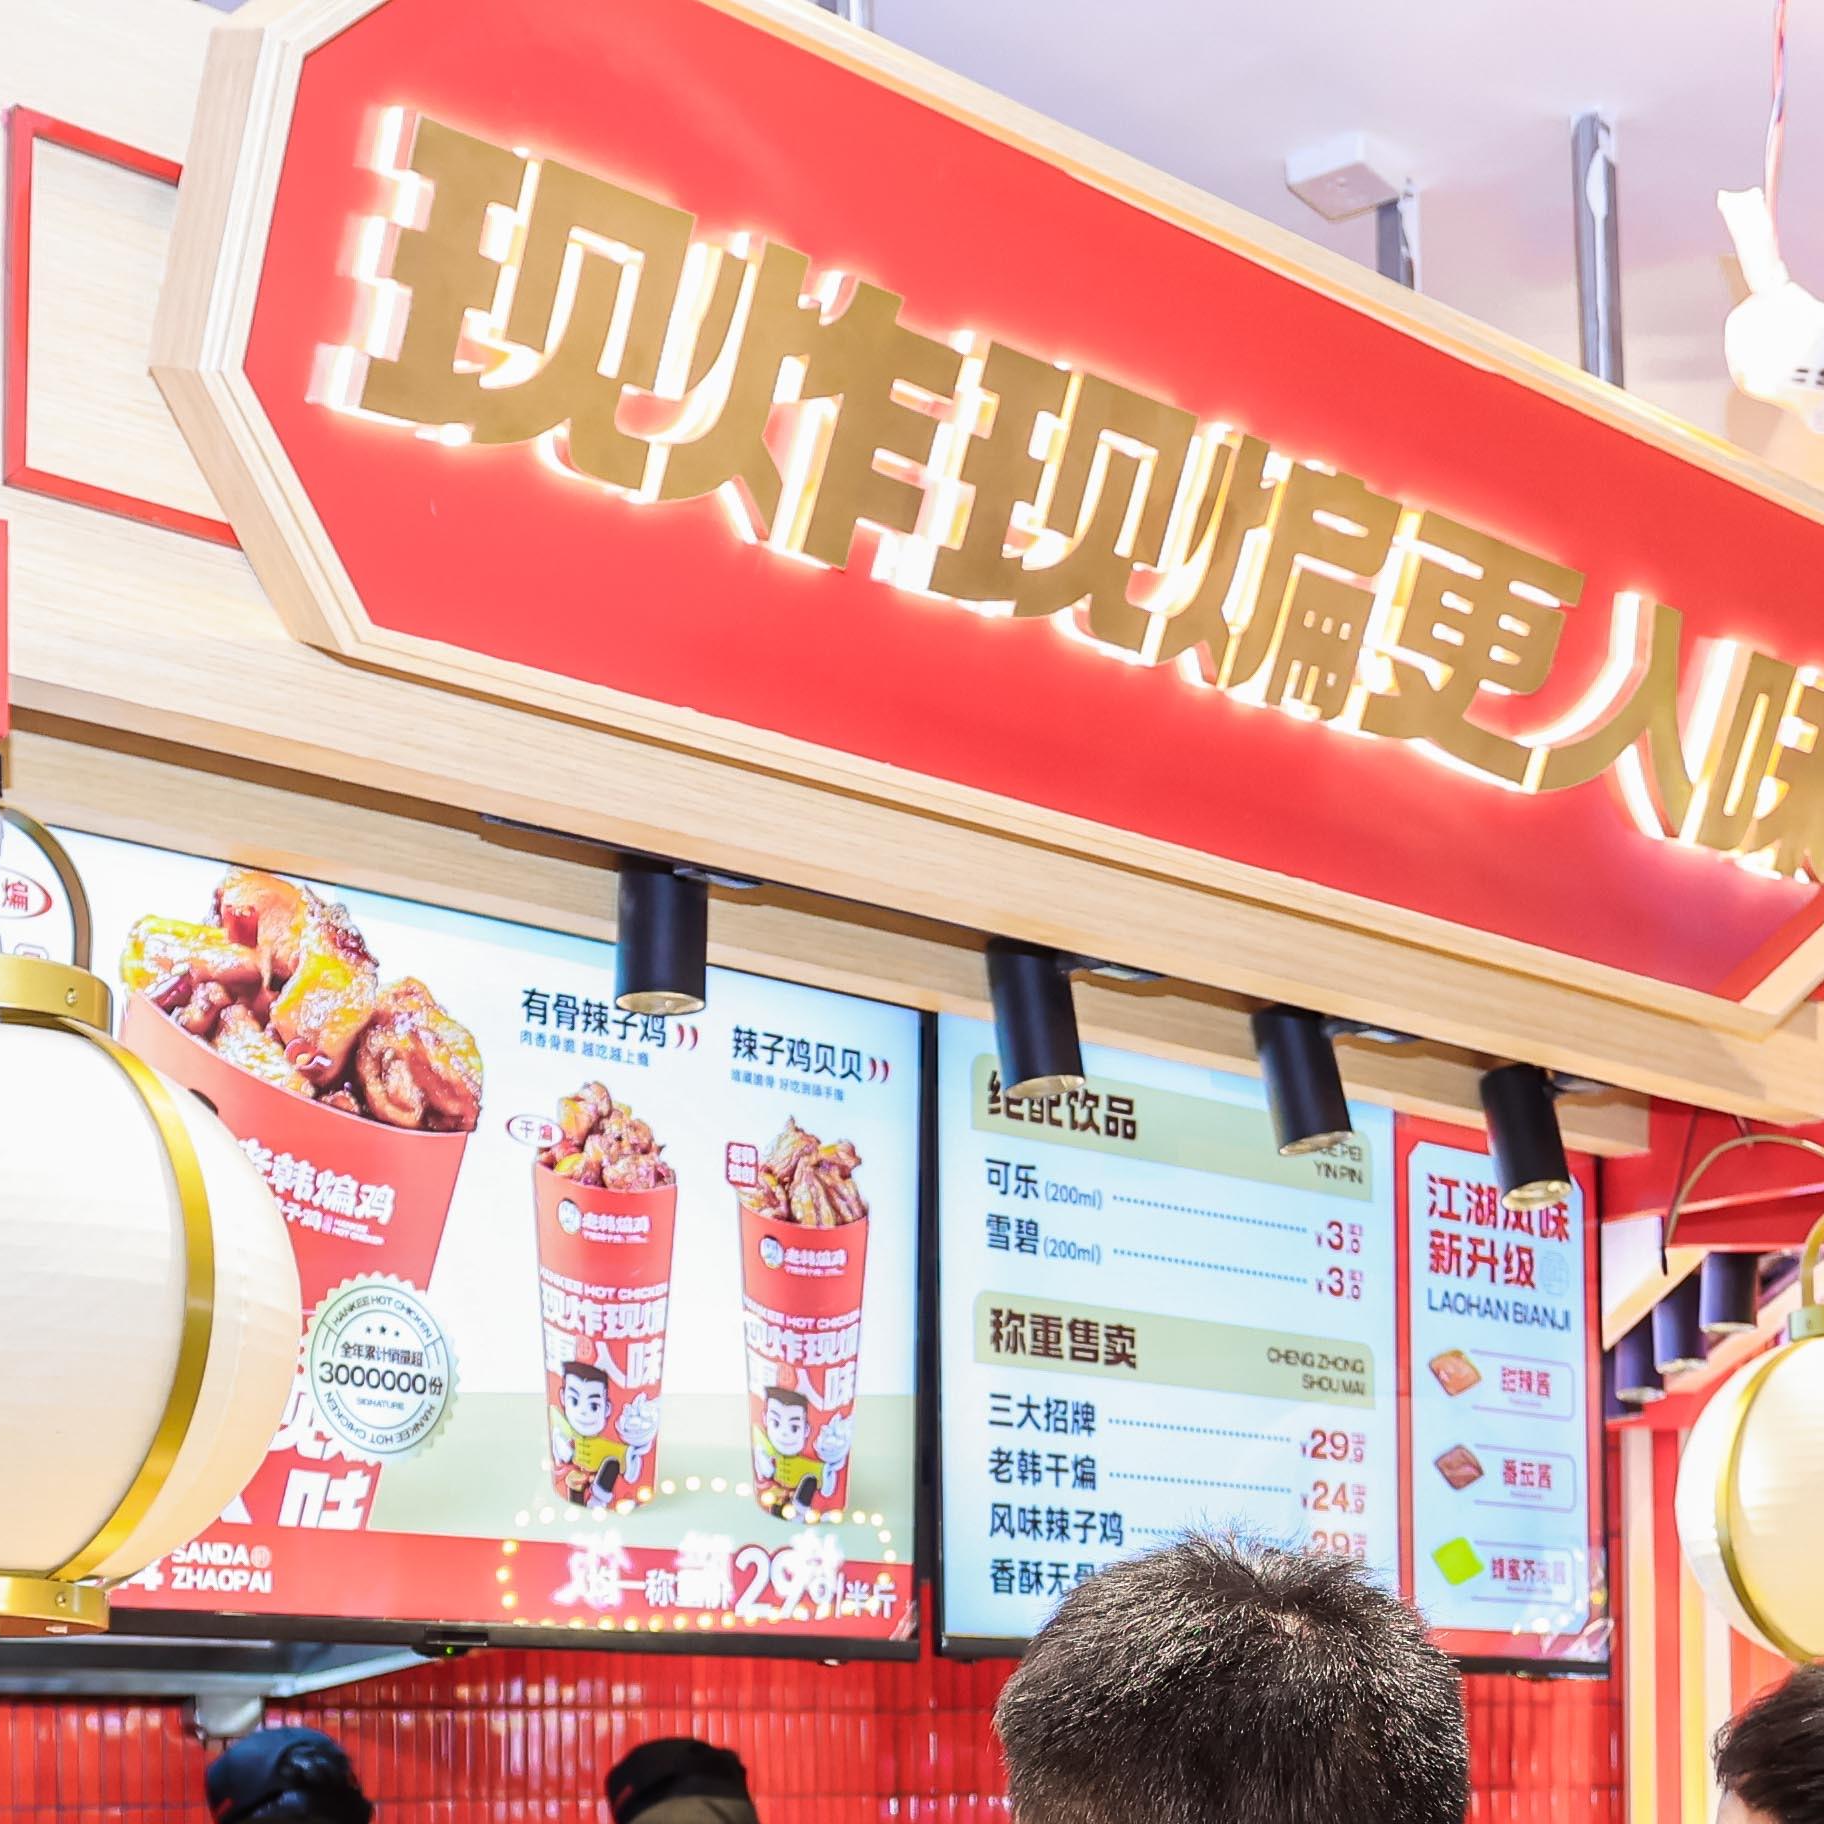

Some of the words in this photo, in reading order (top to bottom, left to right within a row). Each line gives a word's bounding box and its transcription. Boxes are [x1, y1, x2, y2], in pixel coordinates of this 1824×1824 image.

[521, 987, 668, 1048] 有骨辣子鸡
[731, 1024, 864, 1084] 辣子鸡贝贝
[984, 1157, 1040, 1200] 可乐
[985, 1212, 1041, 1257] 雪碧
[1426, 1228, 1538, 1291] 新升级
[370, 1295, 393, 1306] HOT
[1426, 1287, 1511, 1327] LAOHAN
[1513, 1296, 1573, 1332] BIANJI
[988, 1307, 1138, 1371] 称重售卖
[988, 1392, 1098, 1438] 三大招牌
[987, 1446, 1098, 1492] 老韩干煸
[989, 1502, 1124, 1547] 风味辣子鸡
[171, 1541, 251, 1568] SANDA
[169, 1566, 273, 1594] ZHAOPAI
